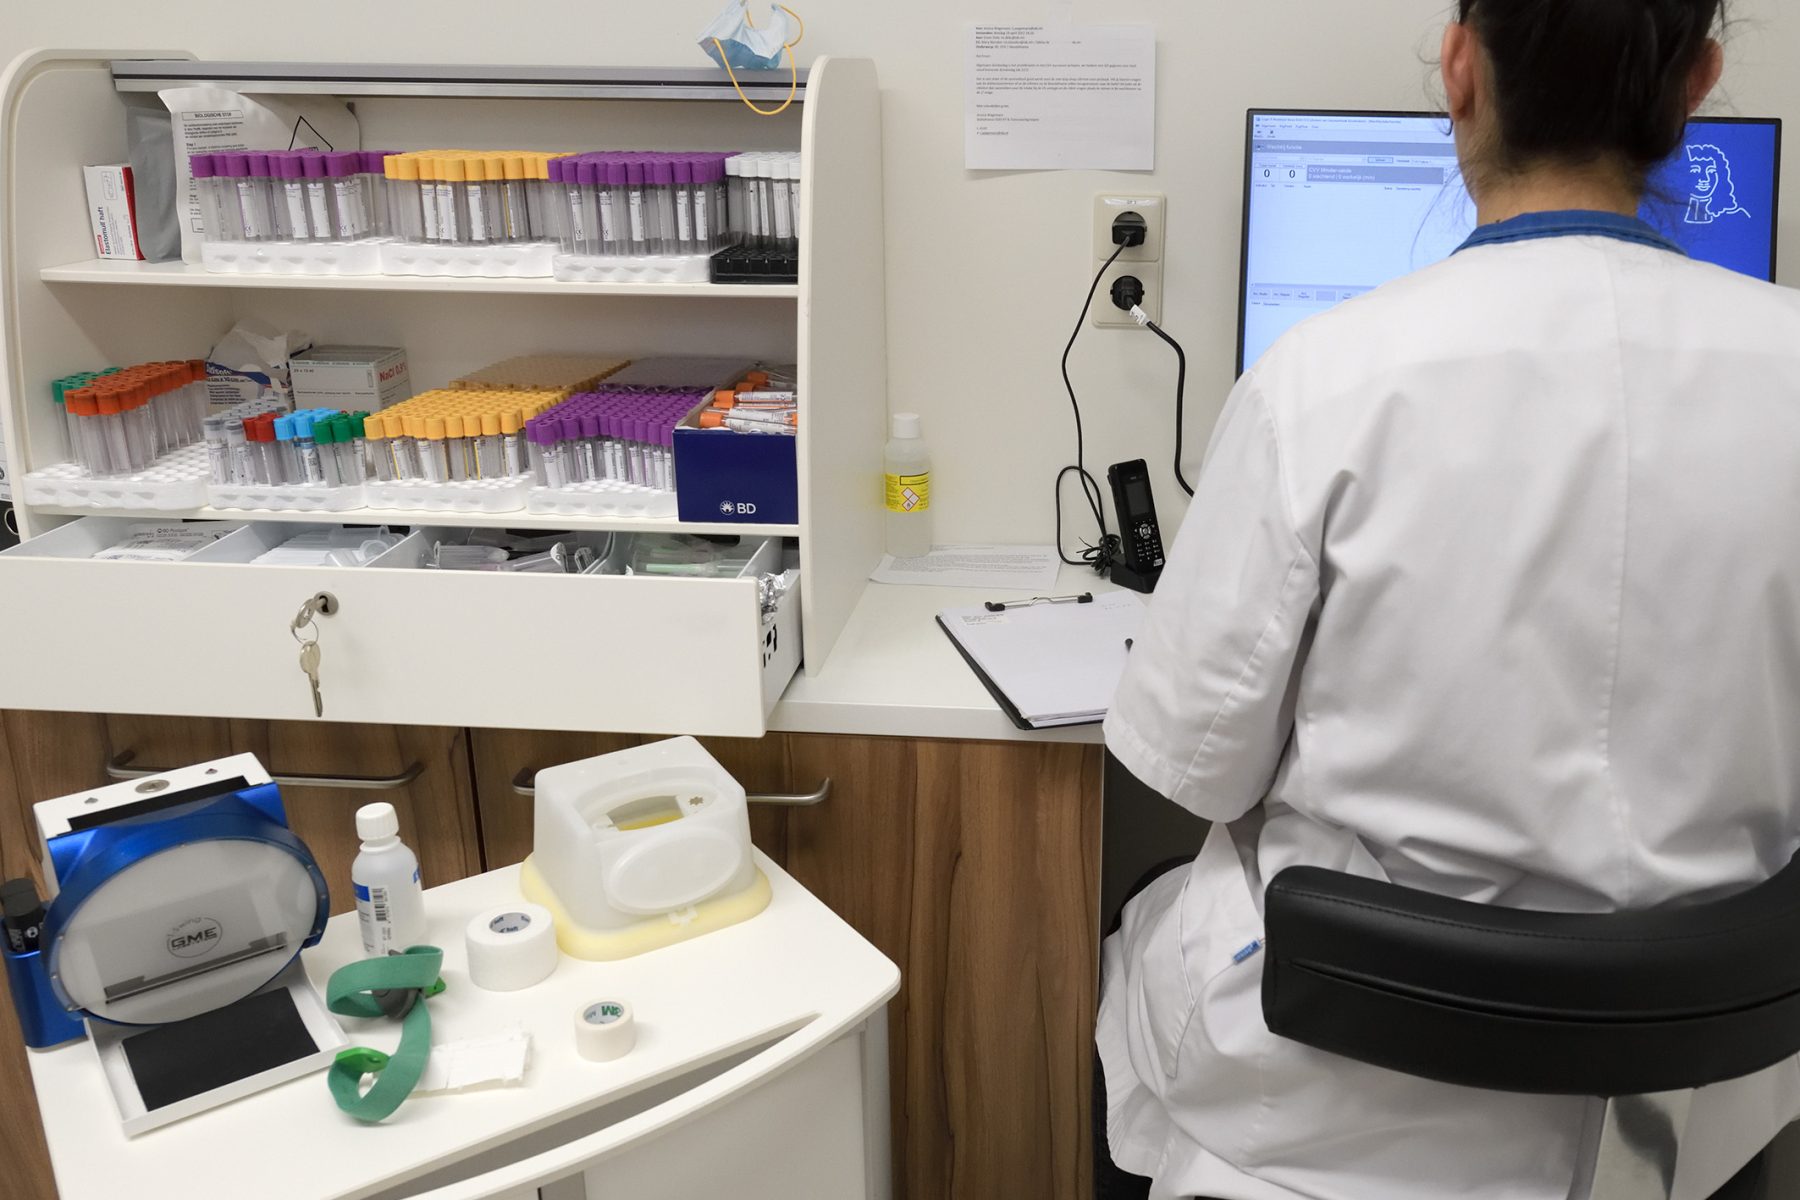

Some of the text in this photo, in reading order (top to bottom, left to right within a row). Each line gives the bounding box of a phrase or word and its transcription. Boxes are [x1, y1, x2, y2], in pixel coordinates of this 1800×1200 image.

[1264, 169, 1295, 178] 0 0
[380, 369, 396, 382] NaCl
[737, 503, 756, 514] BD
[171, 927, 217, 948] GME
